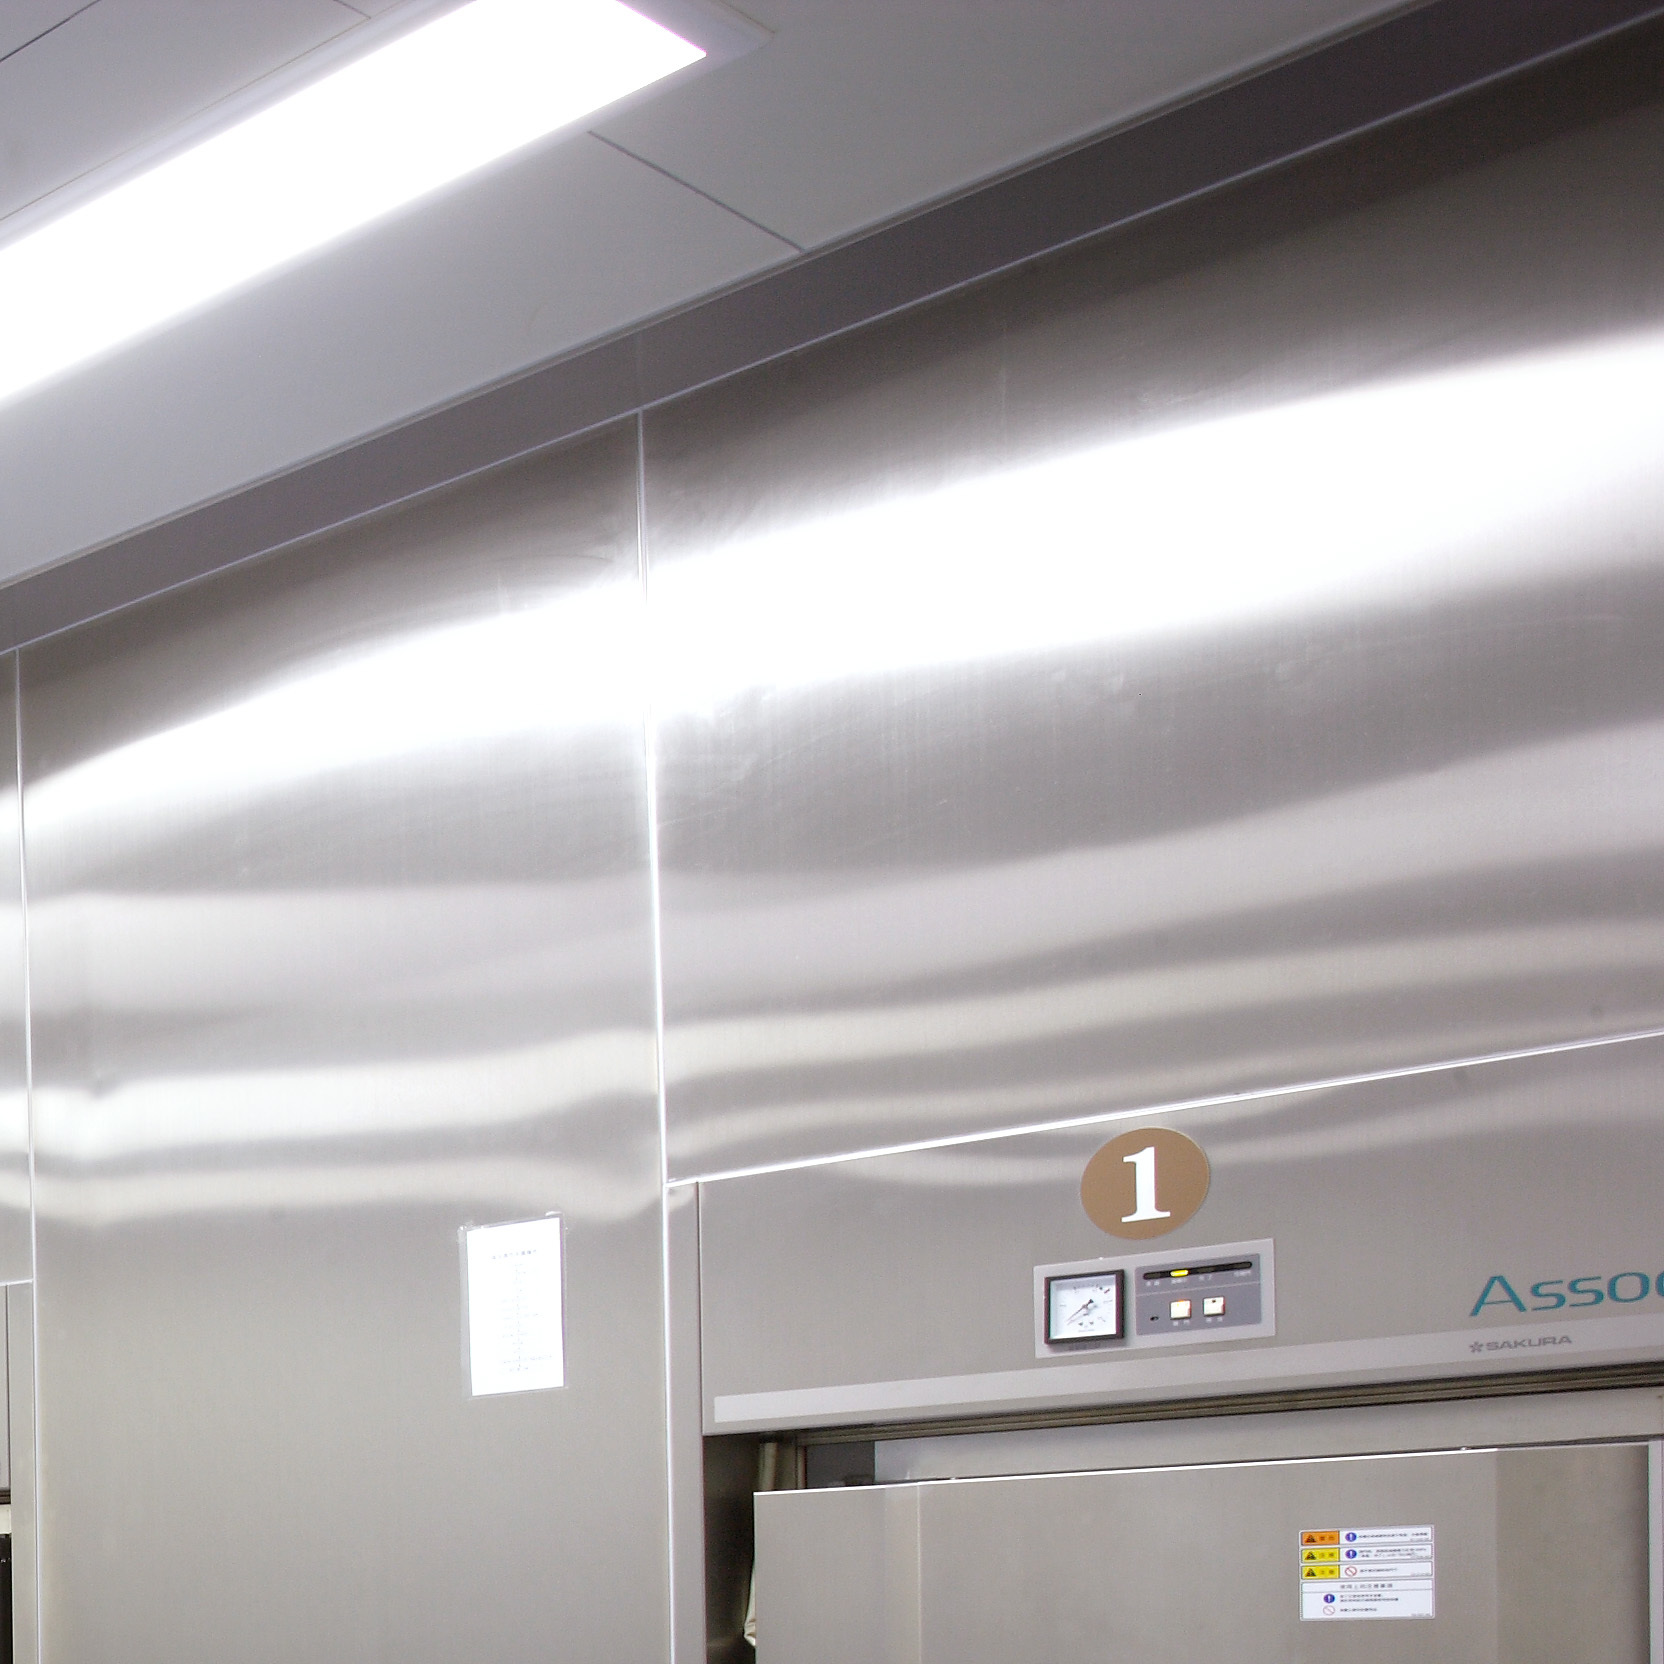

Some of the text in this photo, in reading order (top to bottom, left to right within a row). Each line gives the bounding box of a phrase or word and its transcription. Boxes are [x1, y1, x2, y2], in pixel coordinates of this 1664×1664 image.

[1121, 1146, 1170, 1222] 1
[1469, 1271, 1664, 1317] Asso
[1486, 1336, 1572, 1351] SAKURA
